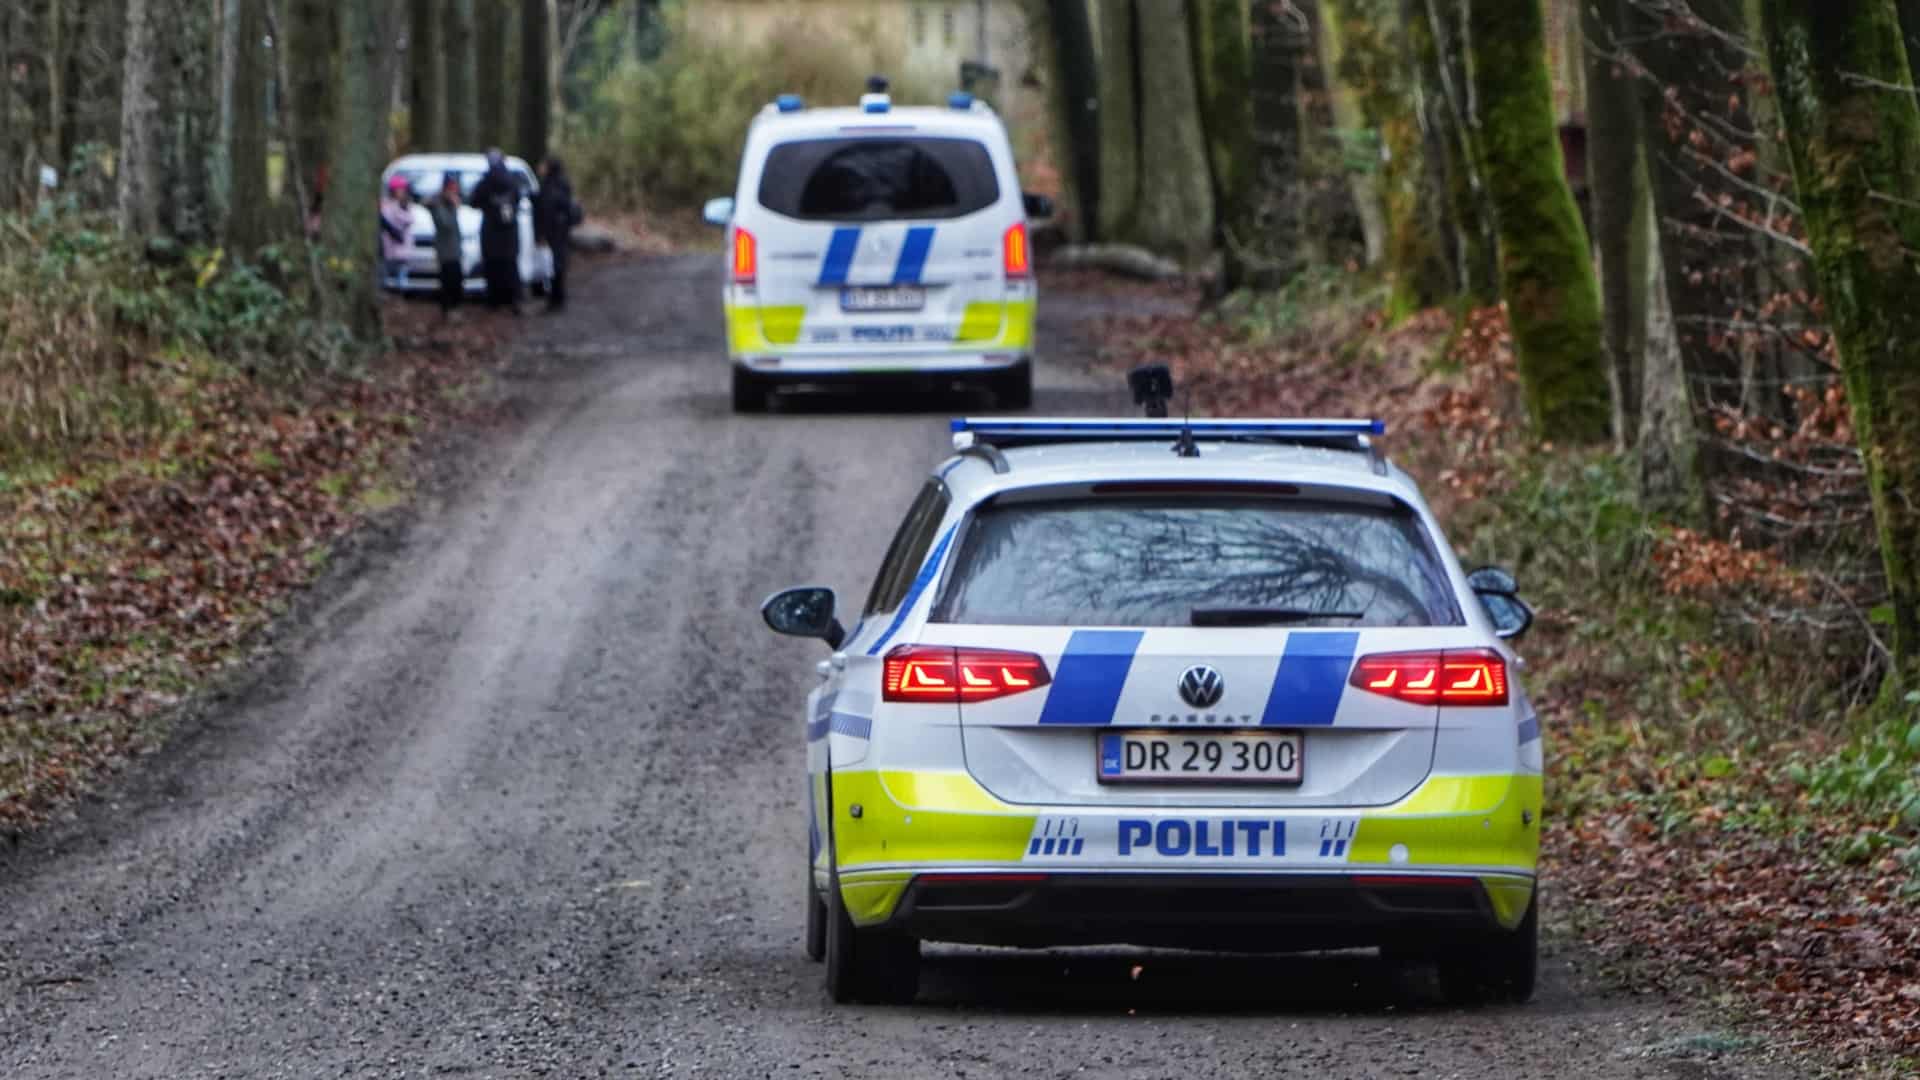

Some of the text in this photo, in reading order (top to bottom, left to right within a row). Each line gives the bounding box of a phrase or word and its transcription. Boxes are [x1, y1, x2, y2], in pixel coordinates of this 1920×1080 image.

[1178, 664, 1224, 708] VW
[1126, 740, 1295, 772] DR 29 300
[1118, 819, 1287, 857] POLITI
